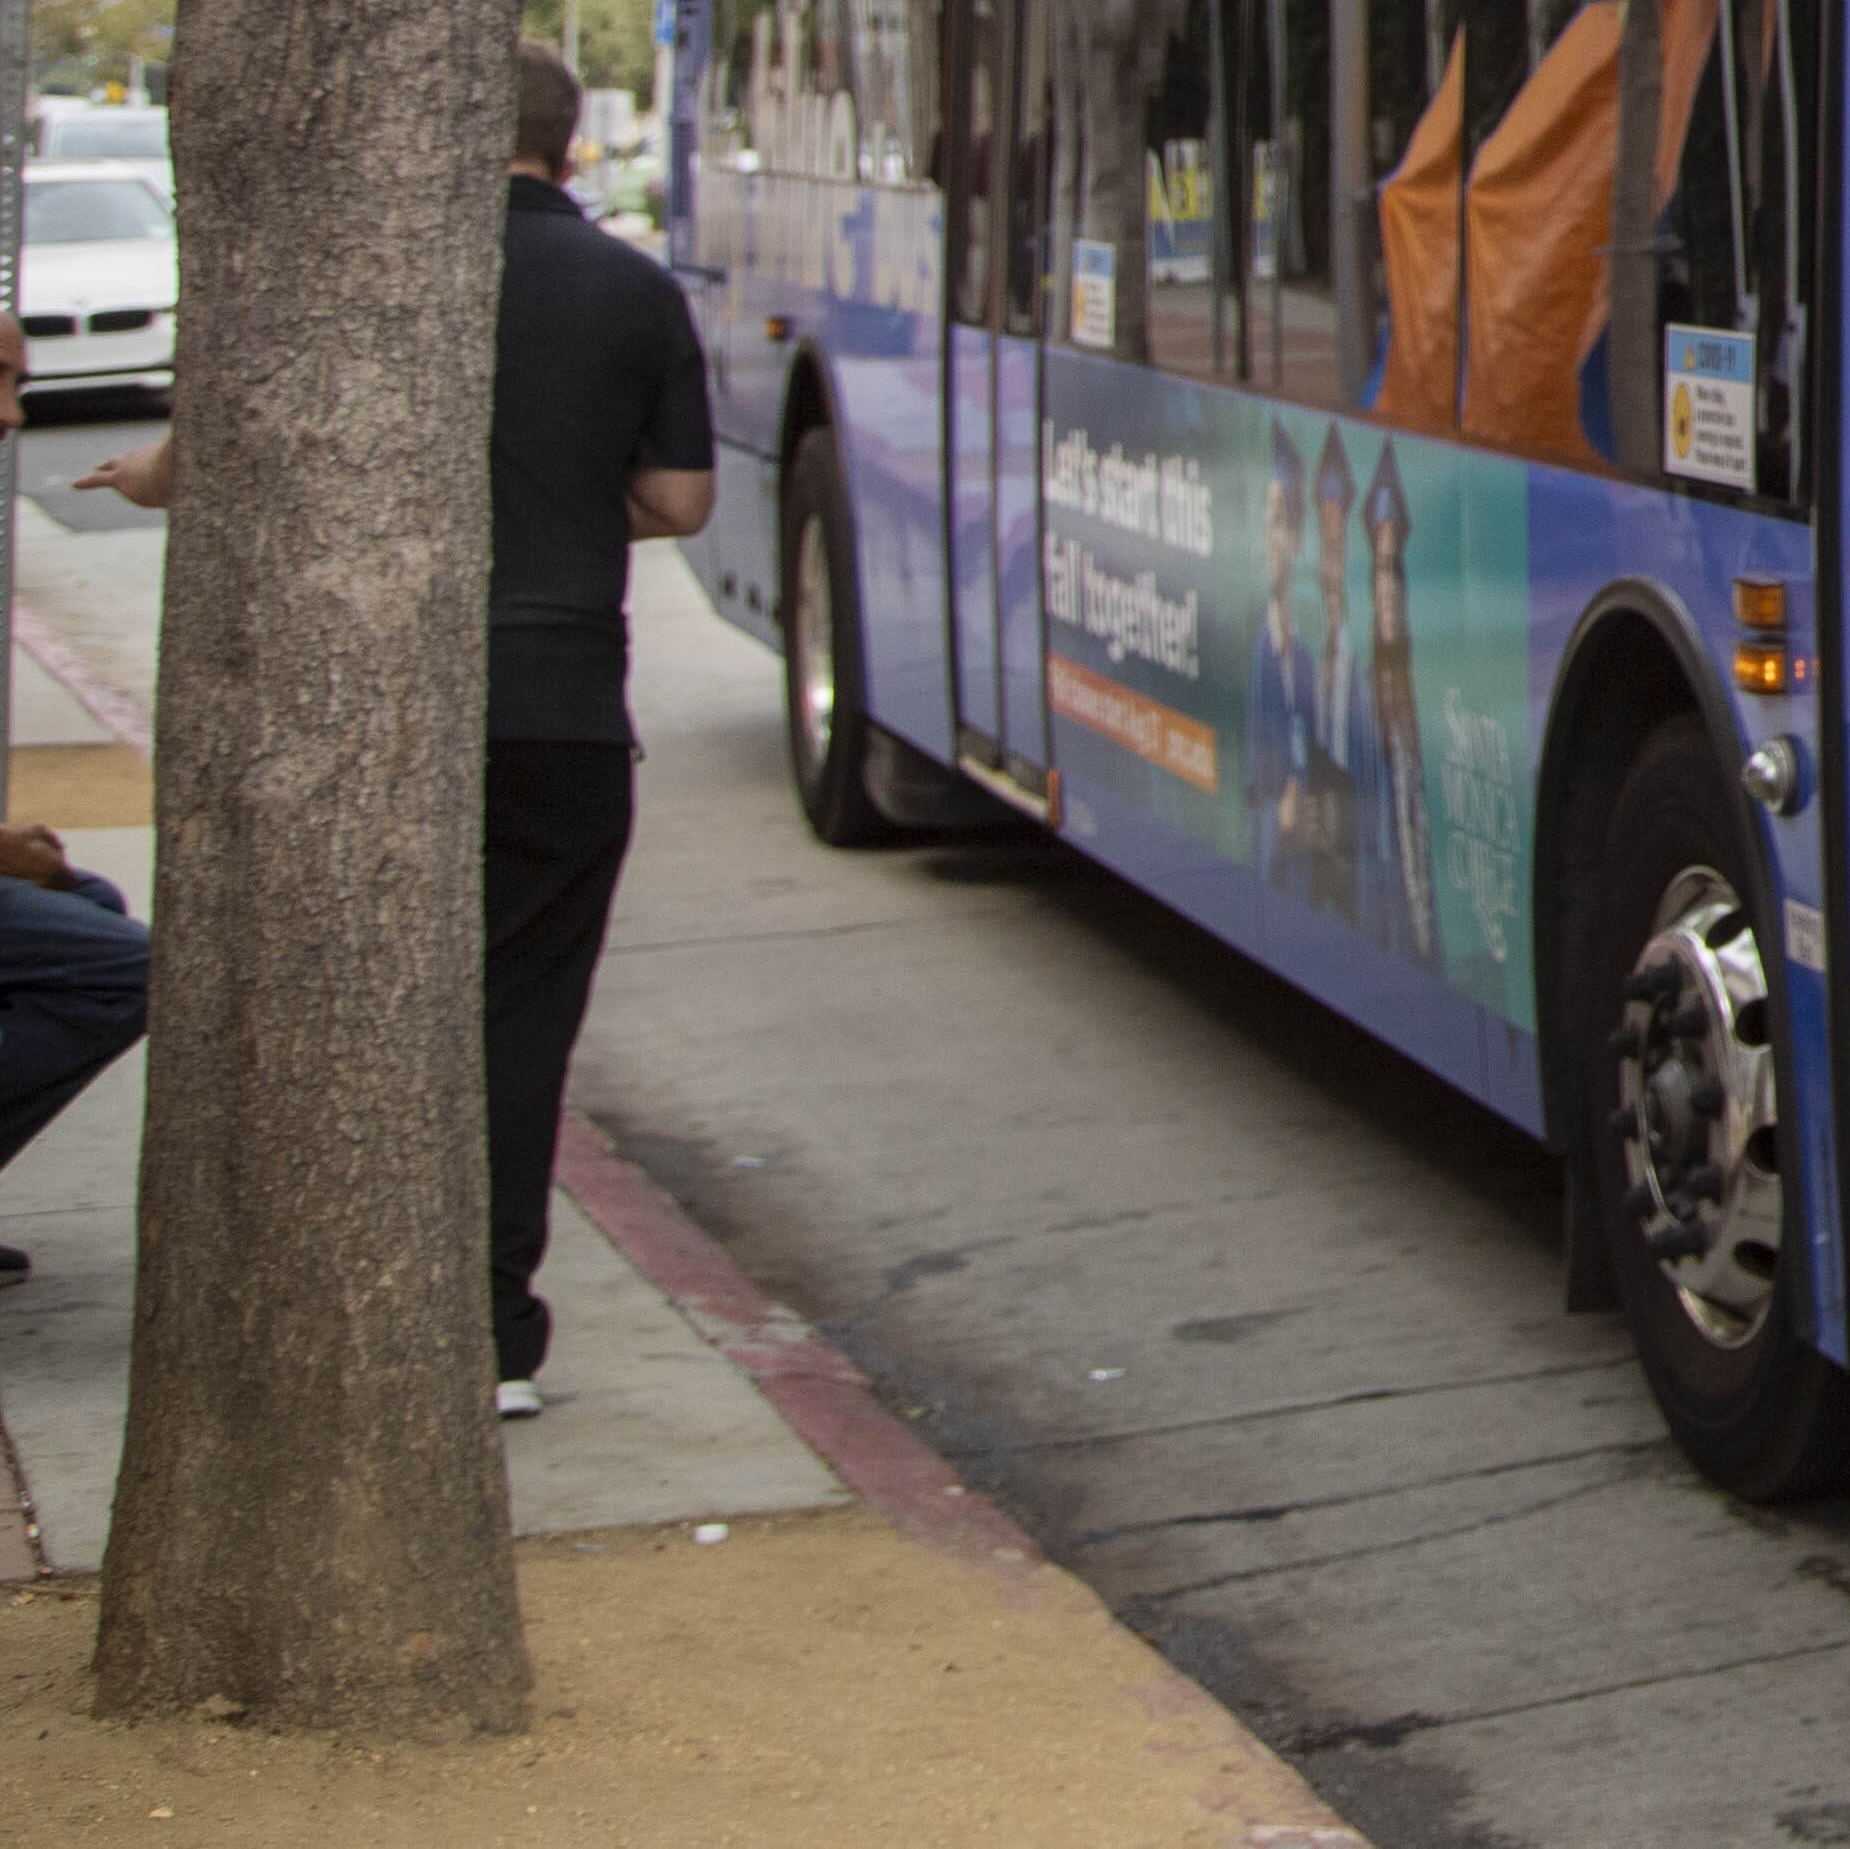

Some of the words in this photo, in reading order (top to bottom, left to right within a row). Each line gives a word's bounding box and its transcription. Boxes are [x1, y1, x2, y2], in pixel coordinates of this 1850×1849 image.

[1043, 418, 1098, 516] Let's
[1100, 441, 1160, 539] start
[1162, 453, 1214, 559] this
